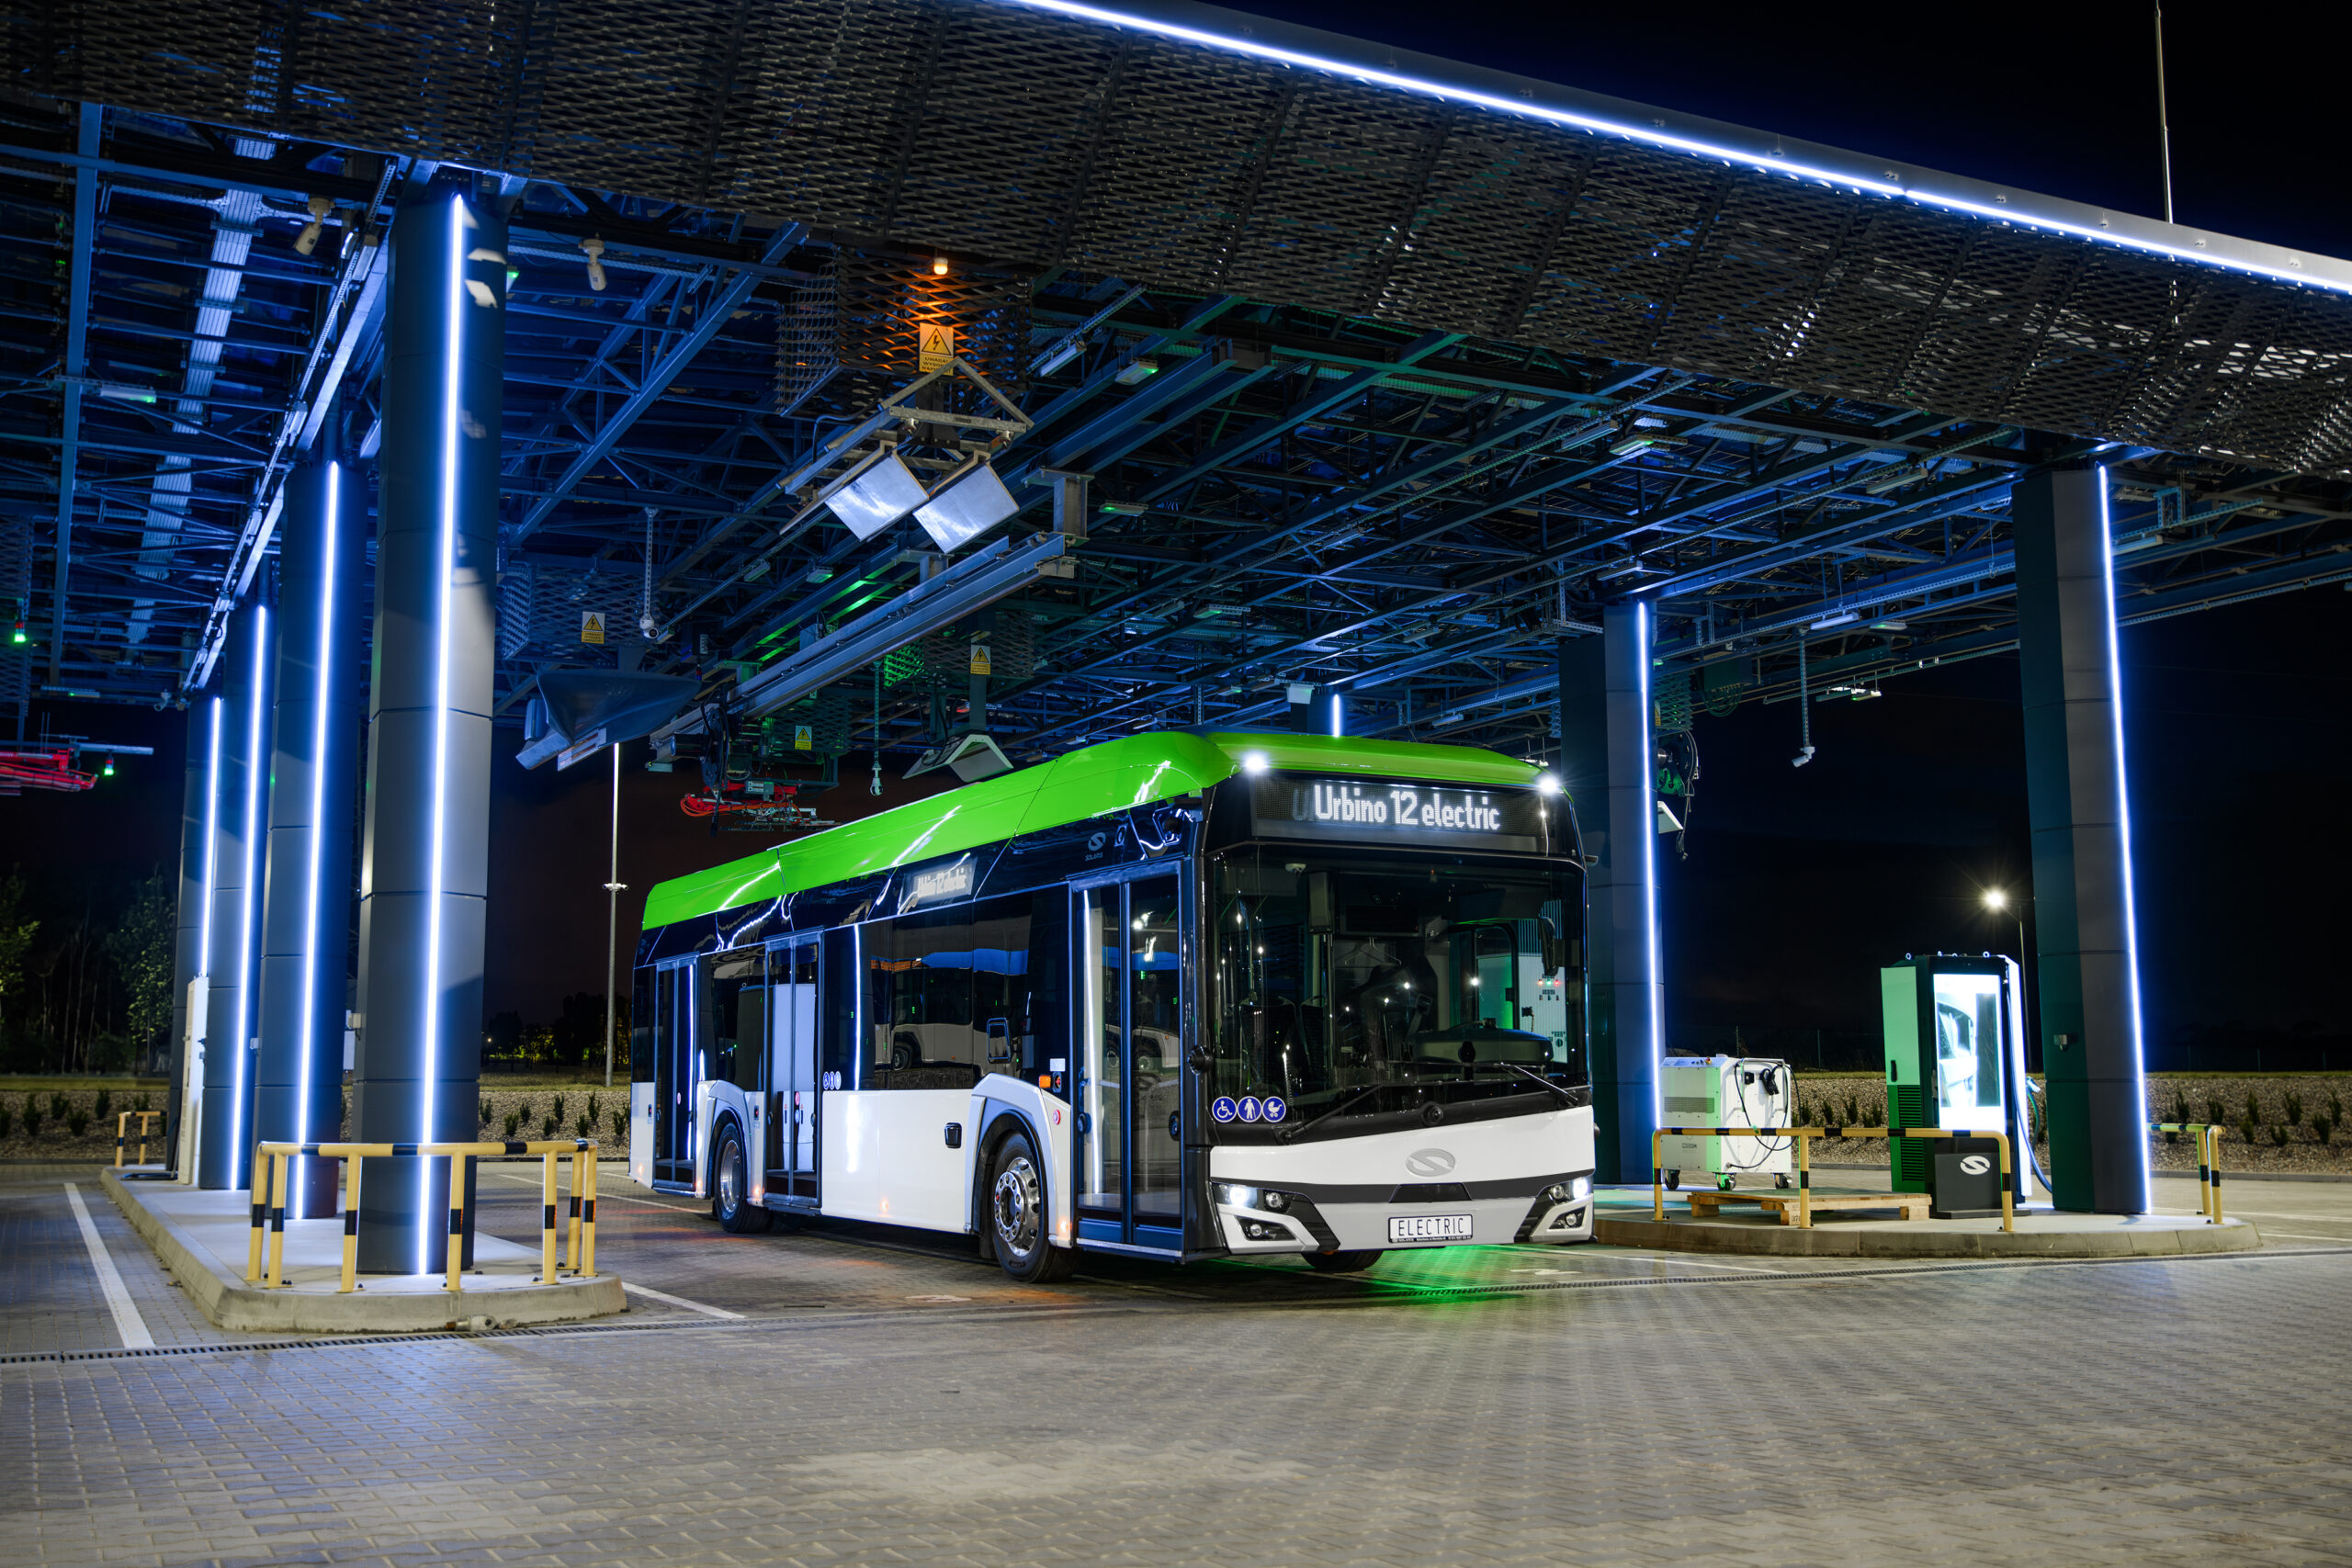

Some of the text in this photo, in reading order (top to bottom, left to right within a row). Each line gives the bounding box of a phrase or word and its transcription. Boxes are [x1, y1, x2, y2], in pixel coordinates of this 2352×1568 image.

[1314, 784, 1500, 830] Urbino 12 electric
[1397, 1217, 1464, 1236] ELECTRIC
